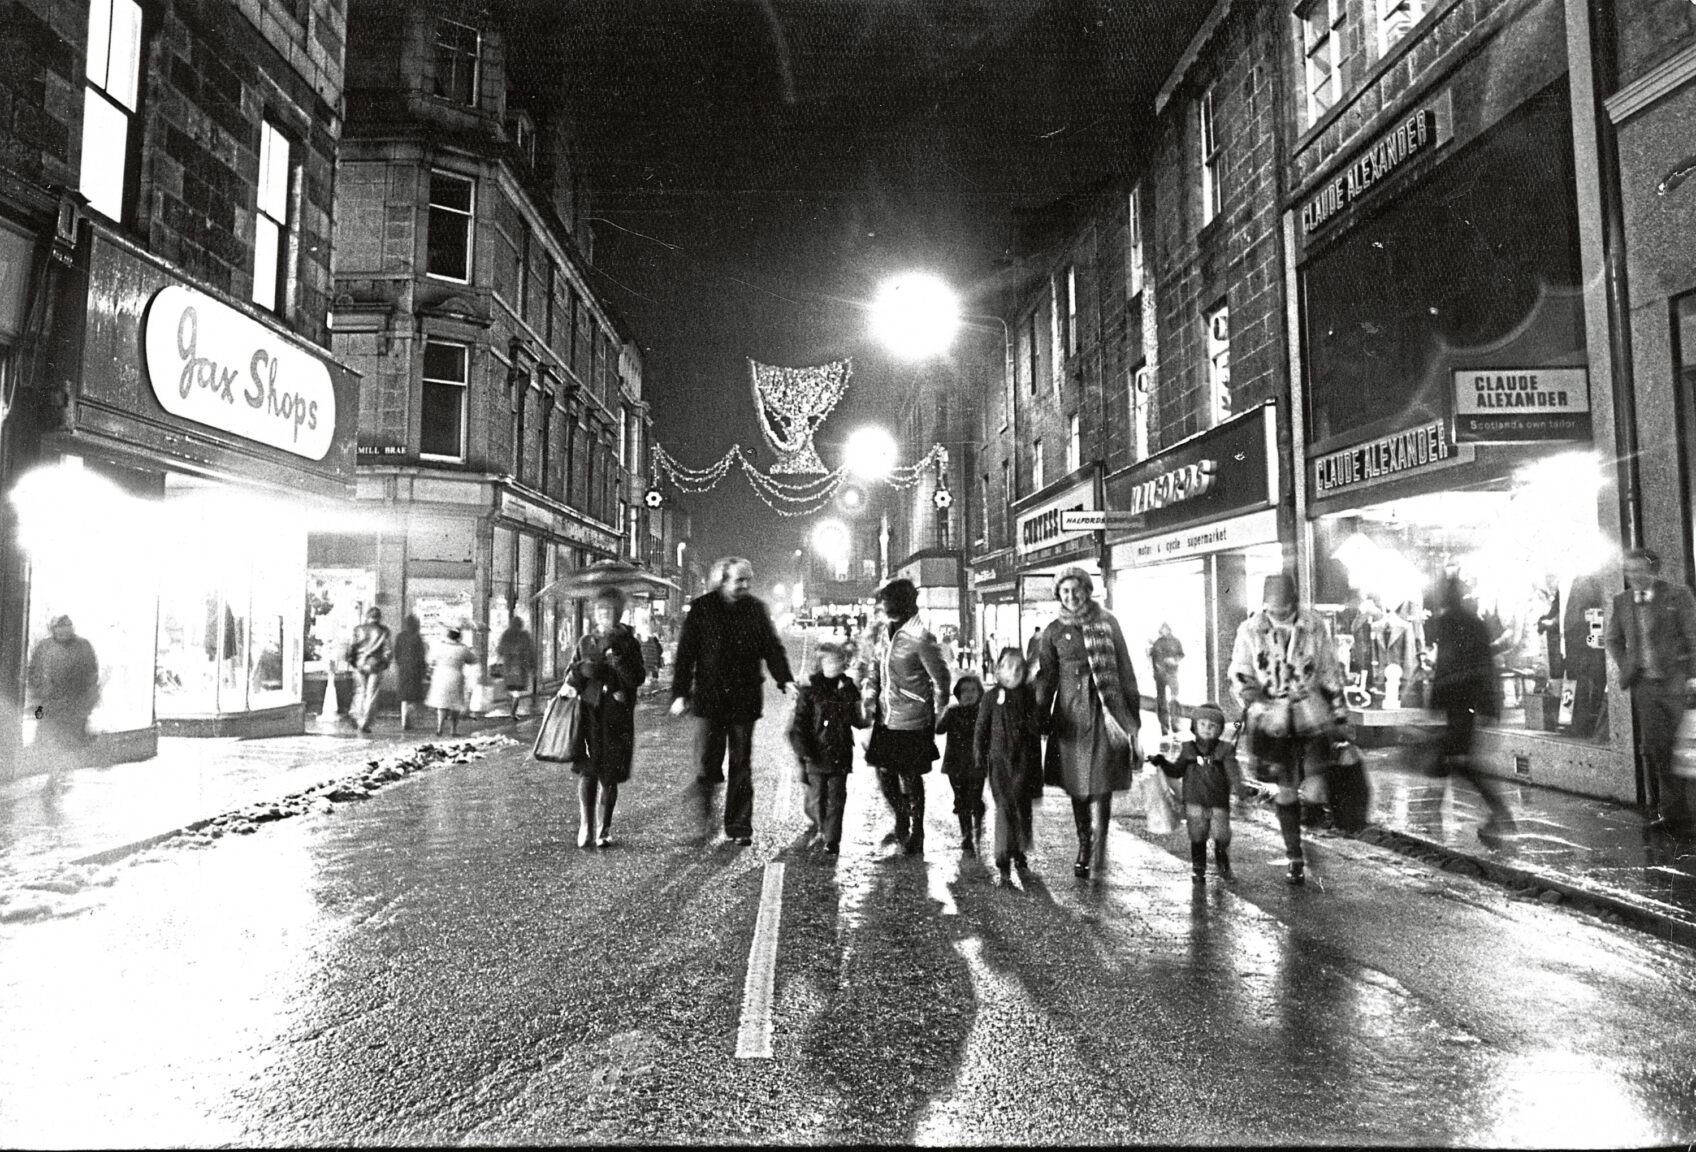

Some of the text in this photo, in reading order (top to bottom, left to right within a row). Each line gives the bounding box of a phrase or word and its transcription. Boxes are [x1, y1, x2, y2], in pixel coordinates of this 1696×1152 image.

[1302, 109, 1427, 235] CLAUDE ALEXANDER
[177, 306, 318, 443] Jax Shops
[1475, 375, 1538, 391] CLAUDE
[1477, 391, 1567, 408] ALEXANDER
[1526, 421, 1547, 429] own
[1549, 420, 1576, 429] tailor
[358, 446, 380, 454] MILL
[1316, 422, 1448, 490] CLAUDE ALEXANDER
[1166, 538, 1181, 553] cycle
[1187, 528, 1227, 549] supermarket
